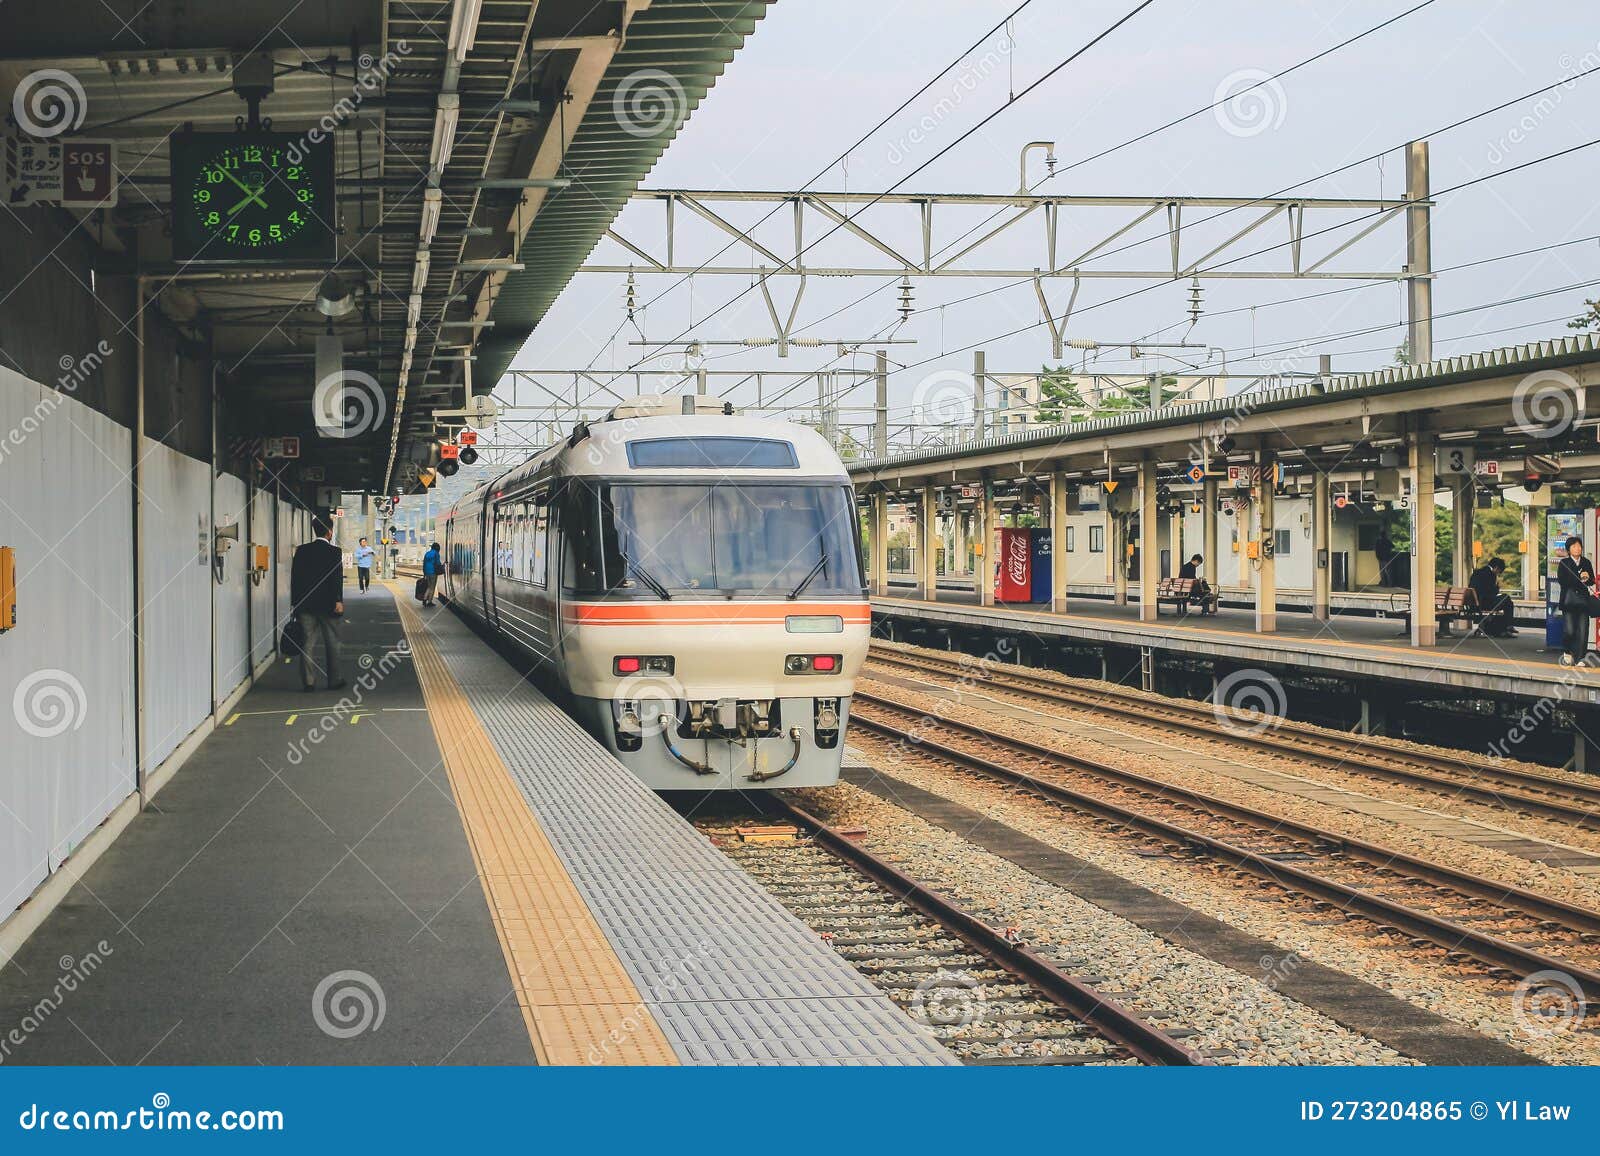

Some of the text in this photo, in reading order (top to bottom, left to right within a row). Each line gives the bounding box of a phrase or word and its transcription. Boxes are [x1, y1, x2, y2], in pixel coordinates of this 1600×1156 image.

[69, 152, 105, 165] SOS
[224, 156, 239, 169] 11
[243, 150, 261, 162] 12
[271, 155, 278, 167] 1
[21, 159, 60, 171] ボタン
[206, 170, 224, 183] 10
[287, 167, 299, 180] 2
[198, 190, 211, 202] 9
[297, 189, 309, 202] 3
[207, 211, 220, 225] 8
[287, 210, 300, 223] 4
[228, 225, 240, 238] 7
[249, 229, 261, 242] 6
[269, 224, 281, 238] 5
[1450, 450, 1463, 472] 3
[1193, 469, 1200, 479] 6
[944, 496, 952, 507] 3
[1401, 496, 1408, 507] 5
